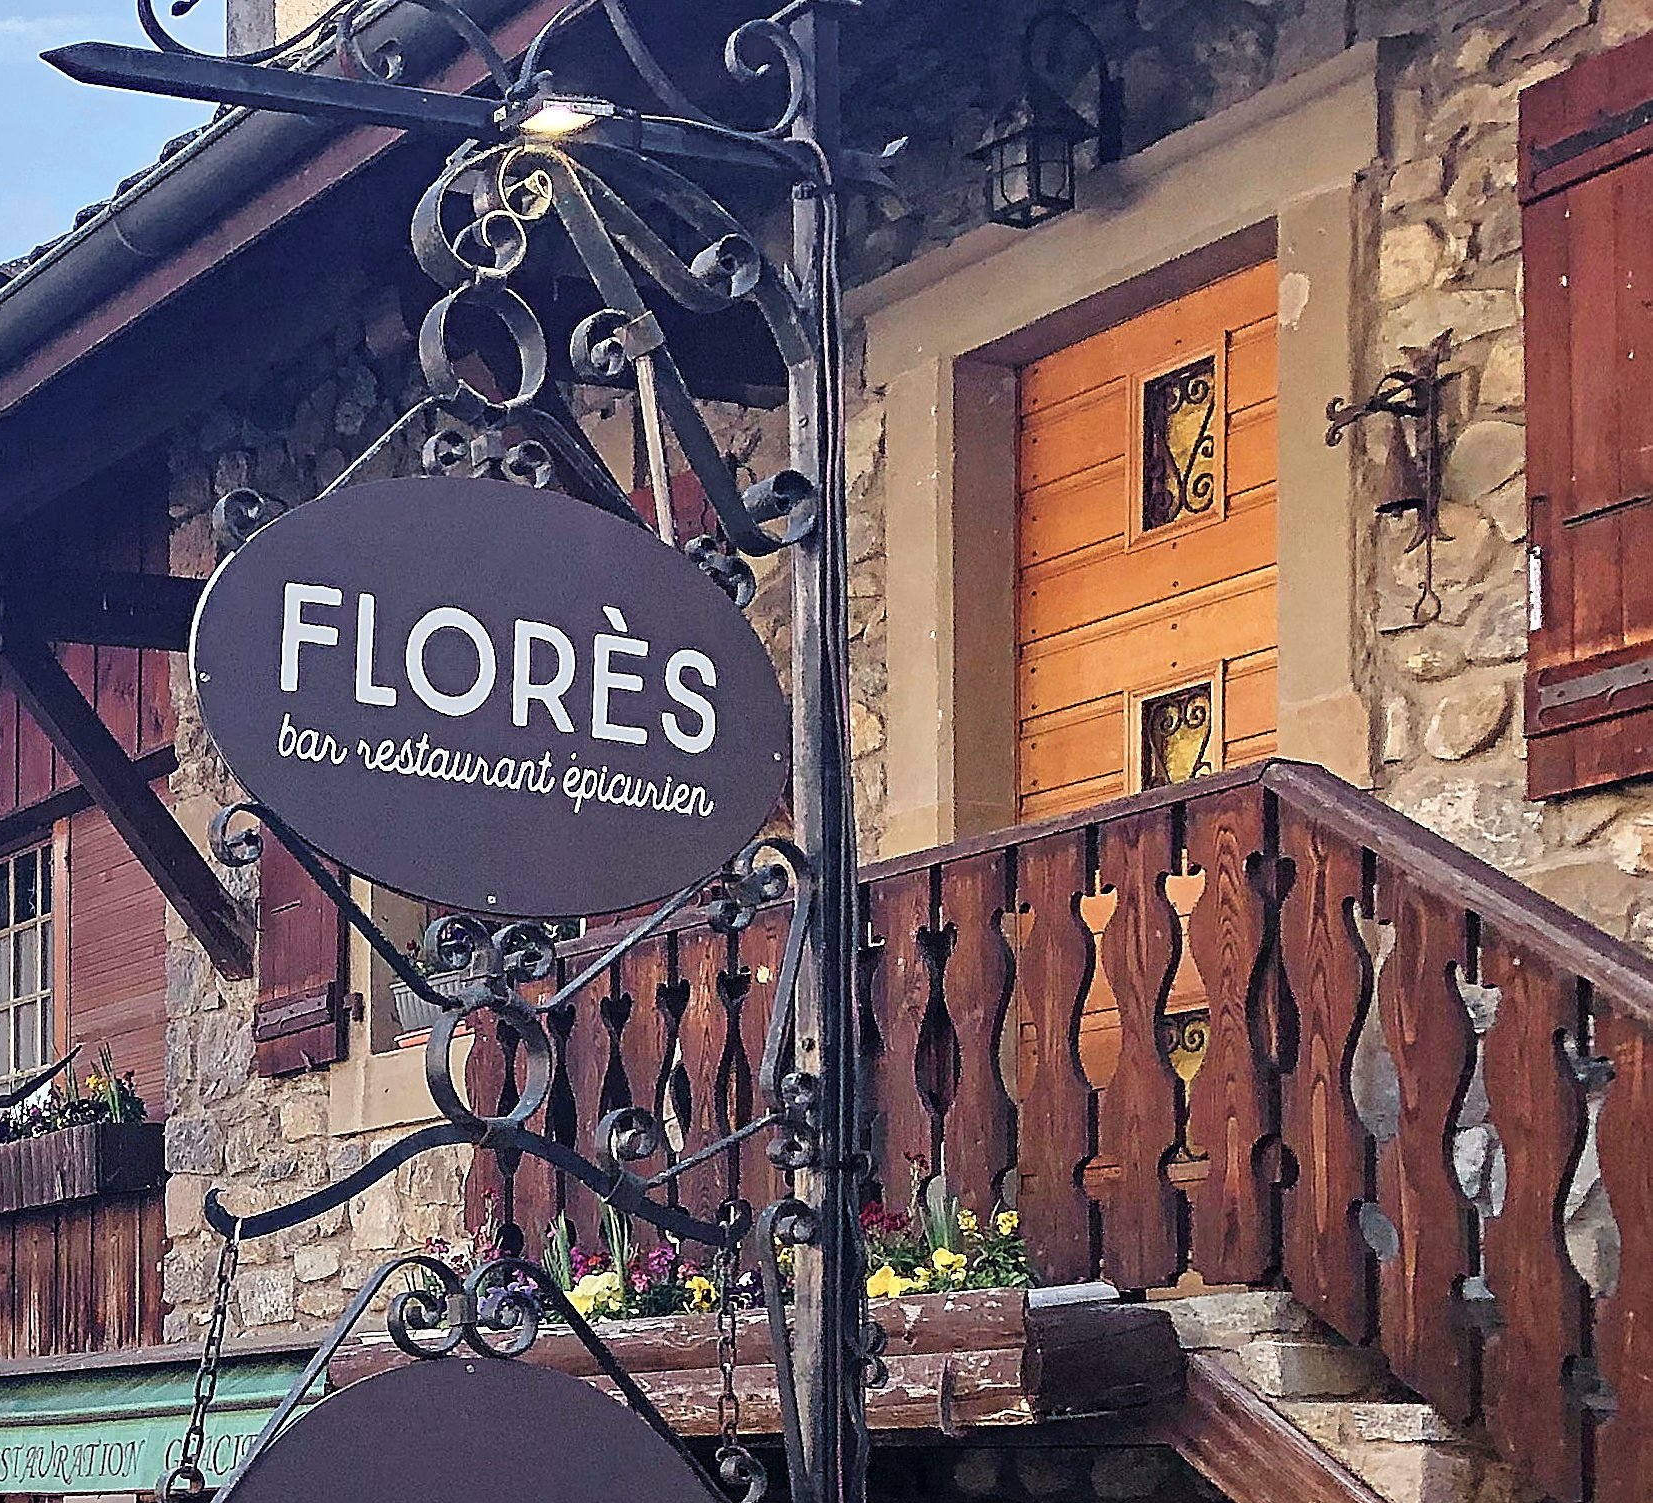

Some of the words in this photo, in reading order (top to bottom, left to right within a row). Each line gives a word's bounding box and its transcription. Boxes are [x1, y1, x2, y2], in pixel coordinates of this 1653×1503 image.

[279, 582, 718, 755] FLORÈS
[278, 712, 347, 765] bar
[356, 731, 556, 794] restaurant
[562, 753, 715, 817] épicurien
